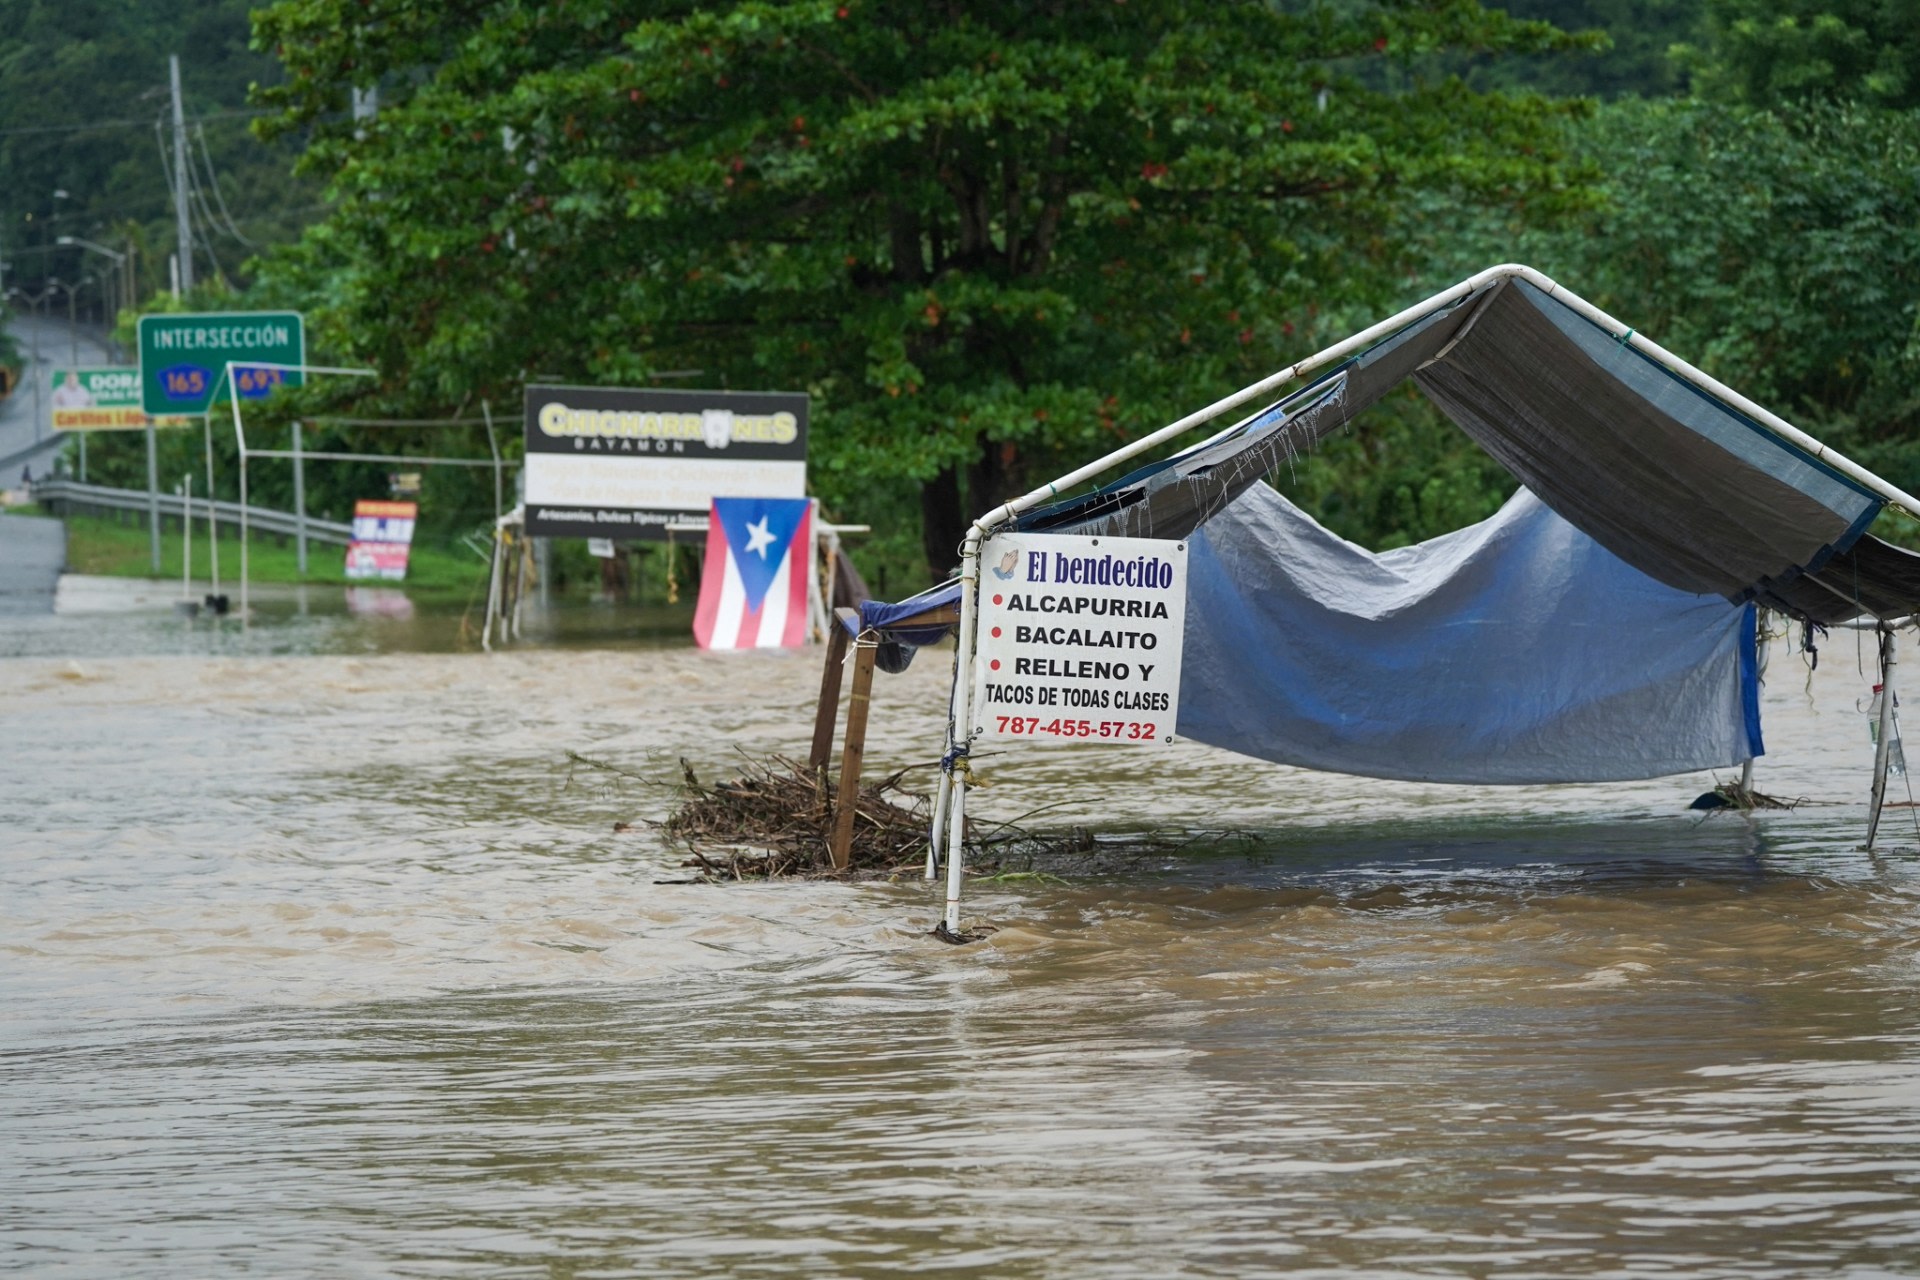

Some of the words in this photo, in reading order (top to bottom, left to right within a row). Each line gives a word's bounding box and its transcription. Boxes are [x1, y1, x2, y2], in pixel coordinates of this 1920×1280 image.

[153, 323, 289, 348] INTERSECCIÓN
[167, 371, 204, 393] 165
[538, 402, 798, 448] CHICHARRONES
[1027, 551, 1047, 582] El
[1055, 552, 1173, 589] bendecido
[1007, 594, 1169, 619] ALCAPURRIA
[1016, 626, 1157, 650] BACALAITO
[1015, 658, 1130, 680] RELLENO
[1138, 664, 1155, 682] Y
[986, 684, 1034, 704] TACOS
[1038, 687, 1058, 705] DE
[1062, 688, 1110, 708] TODAS
[1114, 691, 1169, 711] CLASES
[996, 716, 1156, 740] 787-455-5732
